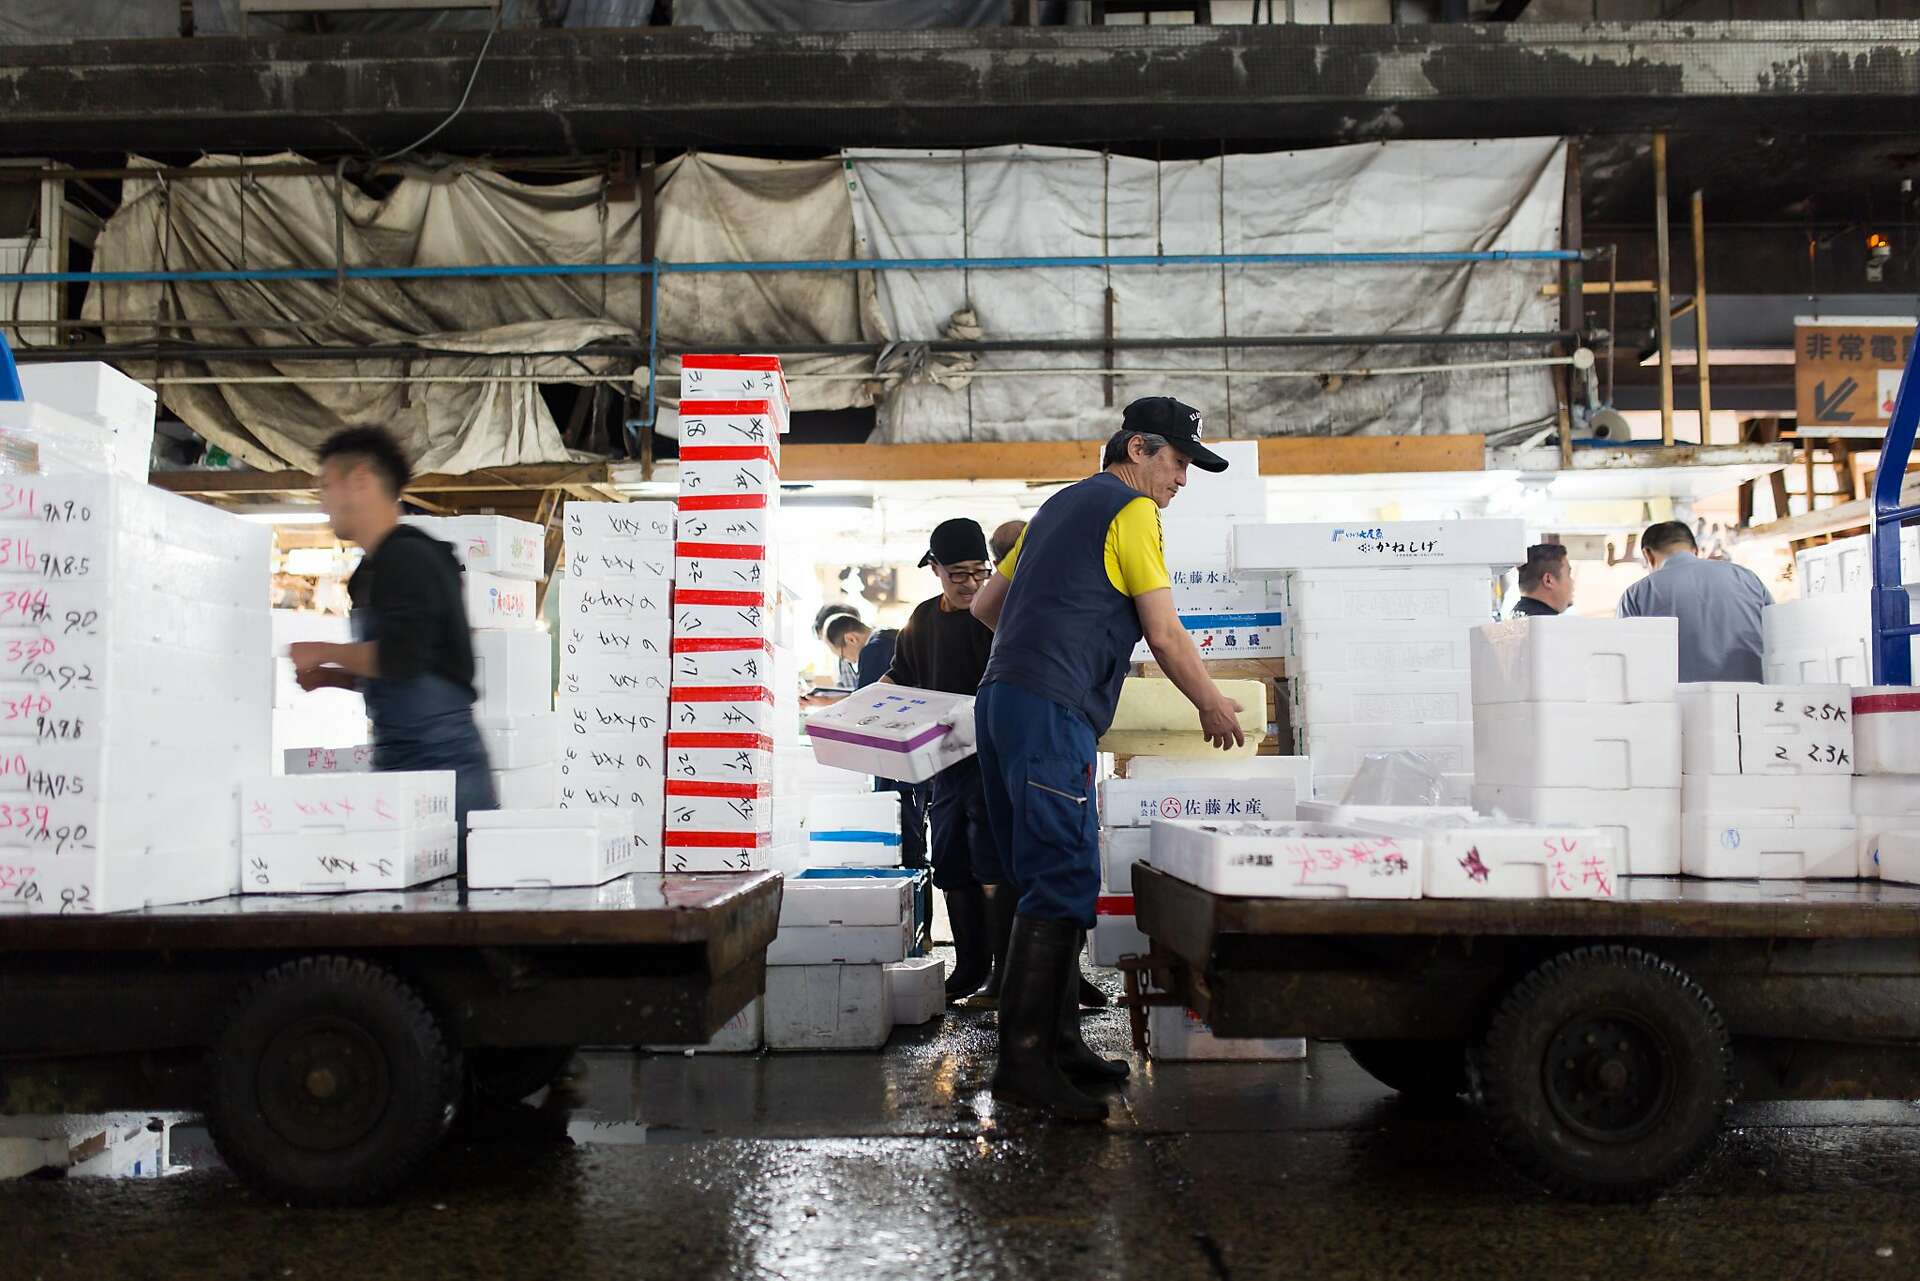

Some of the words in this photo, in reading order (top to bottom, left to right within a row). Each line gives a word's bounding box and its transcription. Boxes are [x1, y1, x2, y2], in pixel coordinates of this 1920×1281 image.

[1775, 745, 1790, 760] 2
[1185, 797, 1263, 817] 佐藤水産
